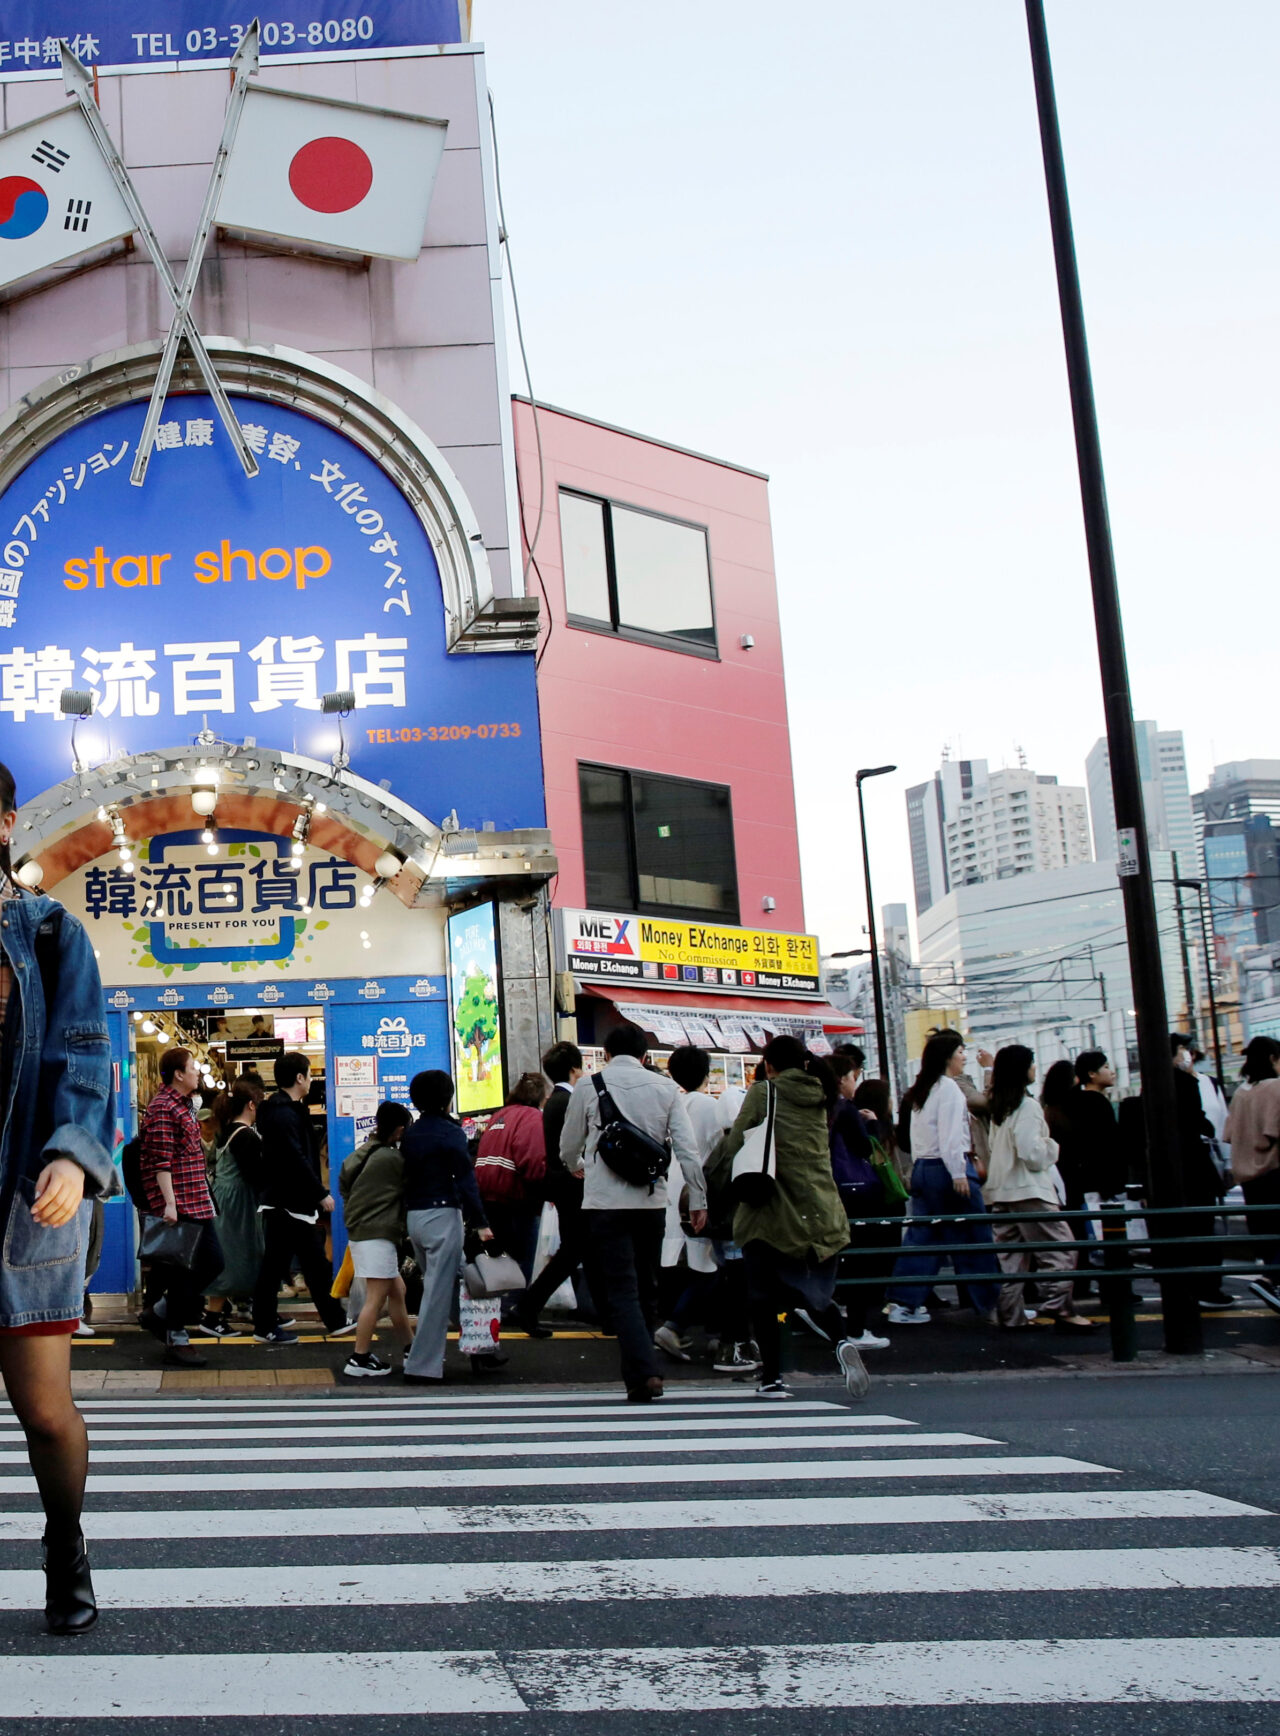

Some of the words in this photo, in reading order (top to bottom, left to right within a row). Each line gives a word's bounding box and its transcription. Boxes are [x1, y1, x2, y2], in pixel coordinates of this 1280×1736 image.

[132, 32, 179, 57] TEL
[186, 15, 374, 54] 03-303-8080
[63, 546, 171, 590] star
[193, 540, 331, 590] shop
[0, 633, 408, 723] 韓流百貨店
[367, 723, 521, 745] TEL:03-3209-0733
[85, 857, 357, 921] 韓流百貨店
[168, 921, 221, 931] PRESENT
[225, 920, 248, 929] FOR
[252, 919, 275, 928] YOU
[579, 915, 633, 944] MEX
[641, 923, 683, 948] Money
[689, 928, 748, 953] EXchange
[753, 935, 780, 957] 외화
[786, 938, 812, 959] 환전
[572, 958, 598, 972] Money
[600, 961, 639, 976] EXchange
[658, 949, 675, 961] No
[678, 950, 738, 968] Commission
[758, 974, 782, 987] Money
[782, 976, 815, 990] EXchange
[362, 1034, 426, 1048] 韓流百貨店
